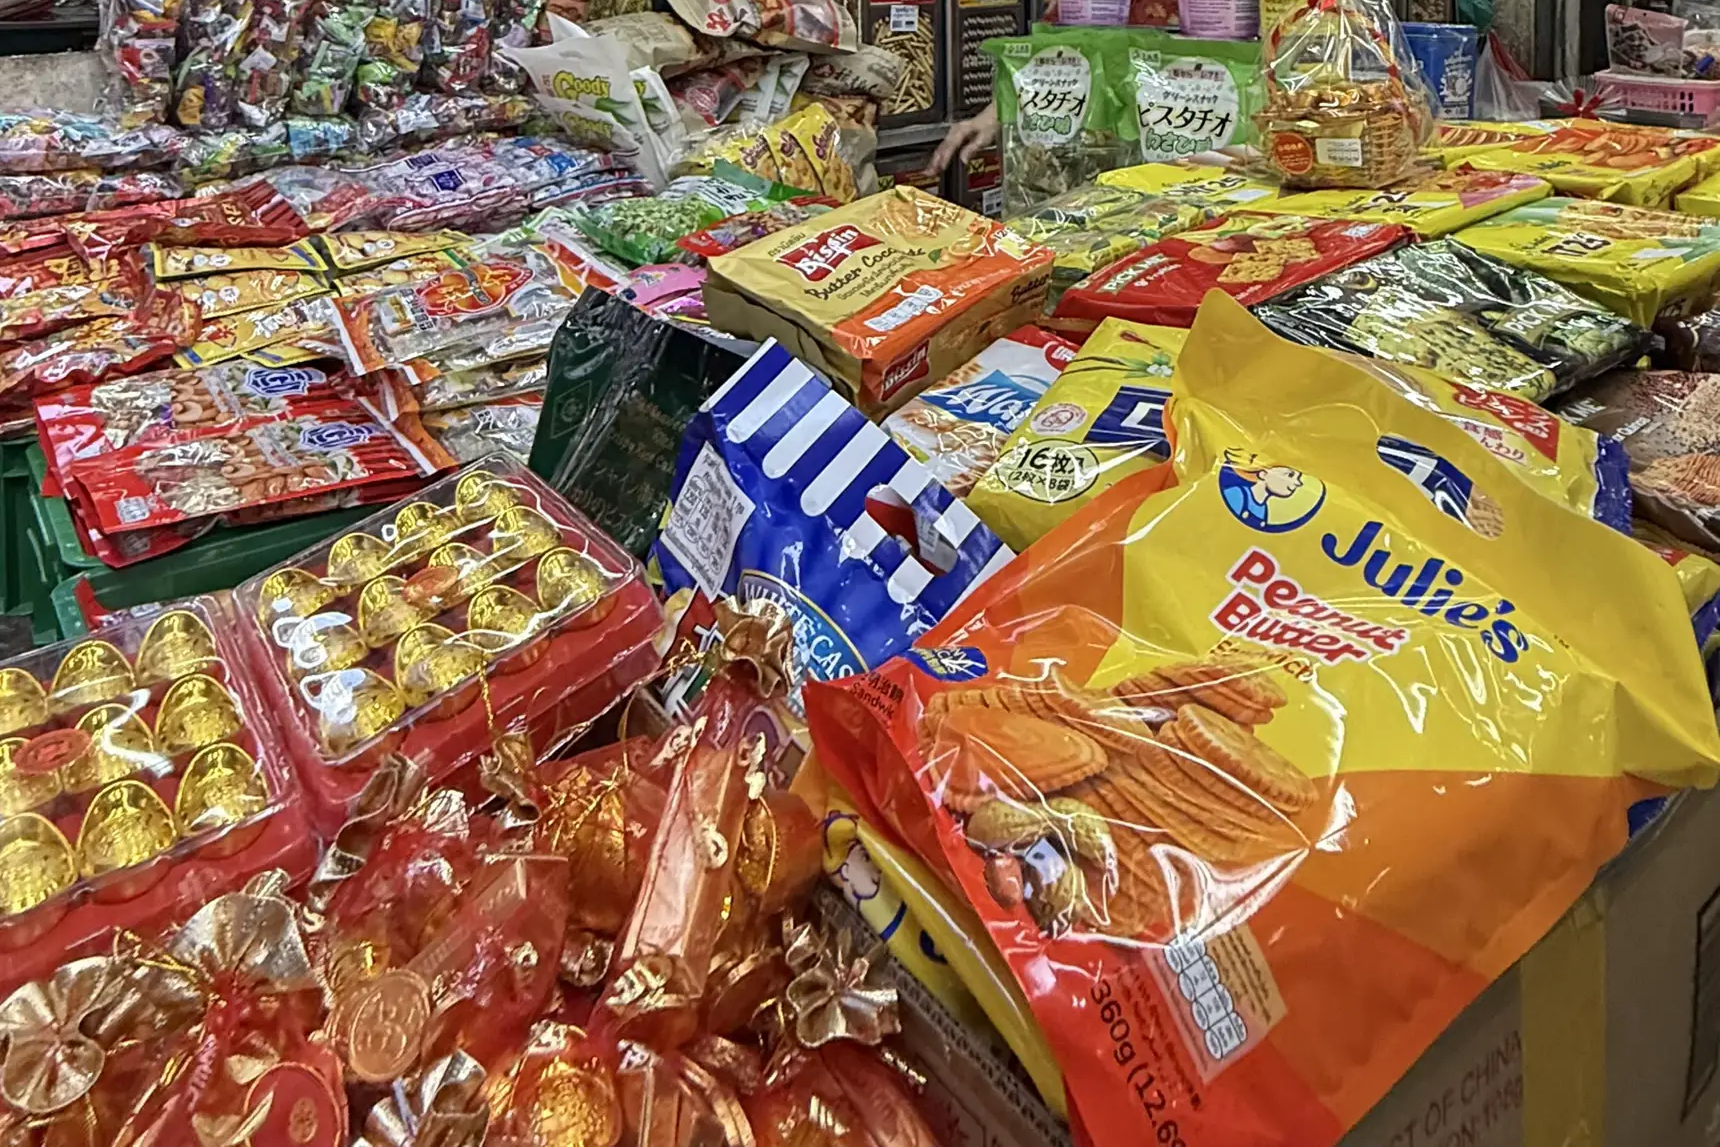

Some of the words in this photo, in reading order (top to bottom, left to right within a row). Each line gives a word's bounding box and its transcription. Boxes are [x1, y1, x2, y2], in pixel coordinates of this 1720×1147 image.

[553, 70, 611, 101] Goody
[1137, 102, 1233, 138] ピスタチオ
[804, 267, 862, 300] Butter
[1230, 549, 1406, 652] Peanut
[1321, 521, 1530, 663] Julie's
[1090, 979, 1136, 1066] 360g
[1424, 1087, 1455, 1138] OF
